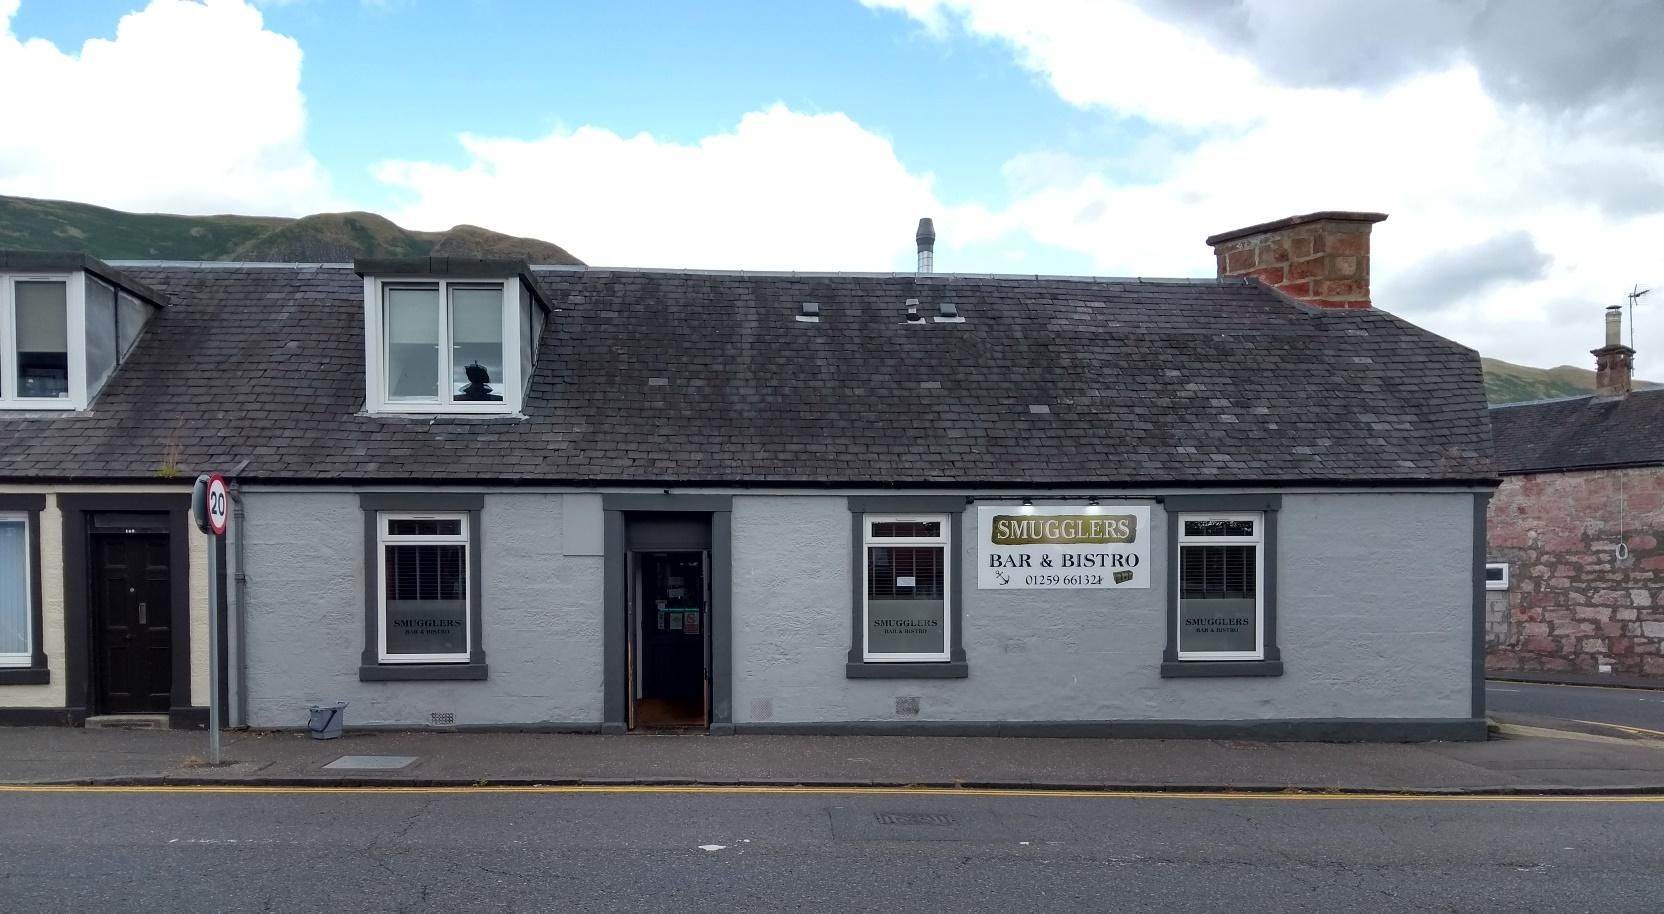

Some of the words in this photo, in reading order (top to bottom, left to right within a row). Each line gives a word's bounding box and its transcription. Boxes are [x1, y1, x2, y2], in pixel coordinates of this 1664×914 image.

[210, 491, 225, 517] 20
[997, 519, 1130, 539] SMUGGLERS
[989, 553, 1032, 568] BAR
[1039, 553, 1053, 568] &
[1061, 553, 1140, 568] BISTRO
[1025, 574, 1060, 586] 01259
[393, 619, 462, 628] SMUGGLERS
[873, 618, 939, 628] SMUGGLERS
[1184, 617, 1249, 626] SMUGGLERS
